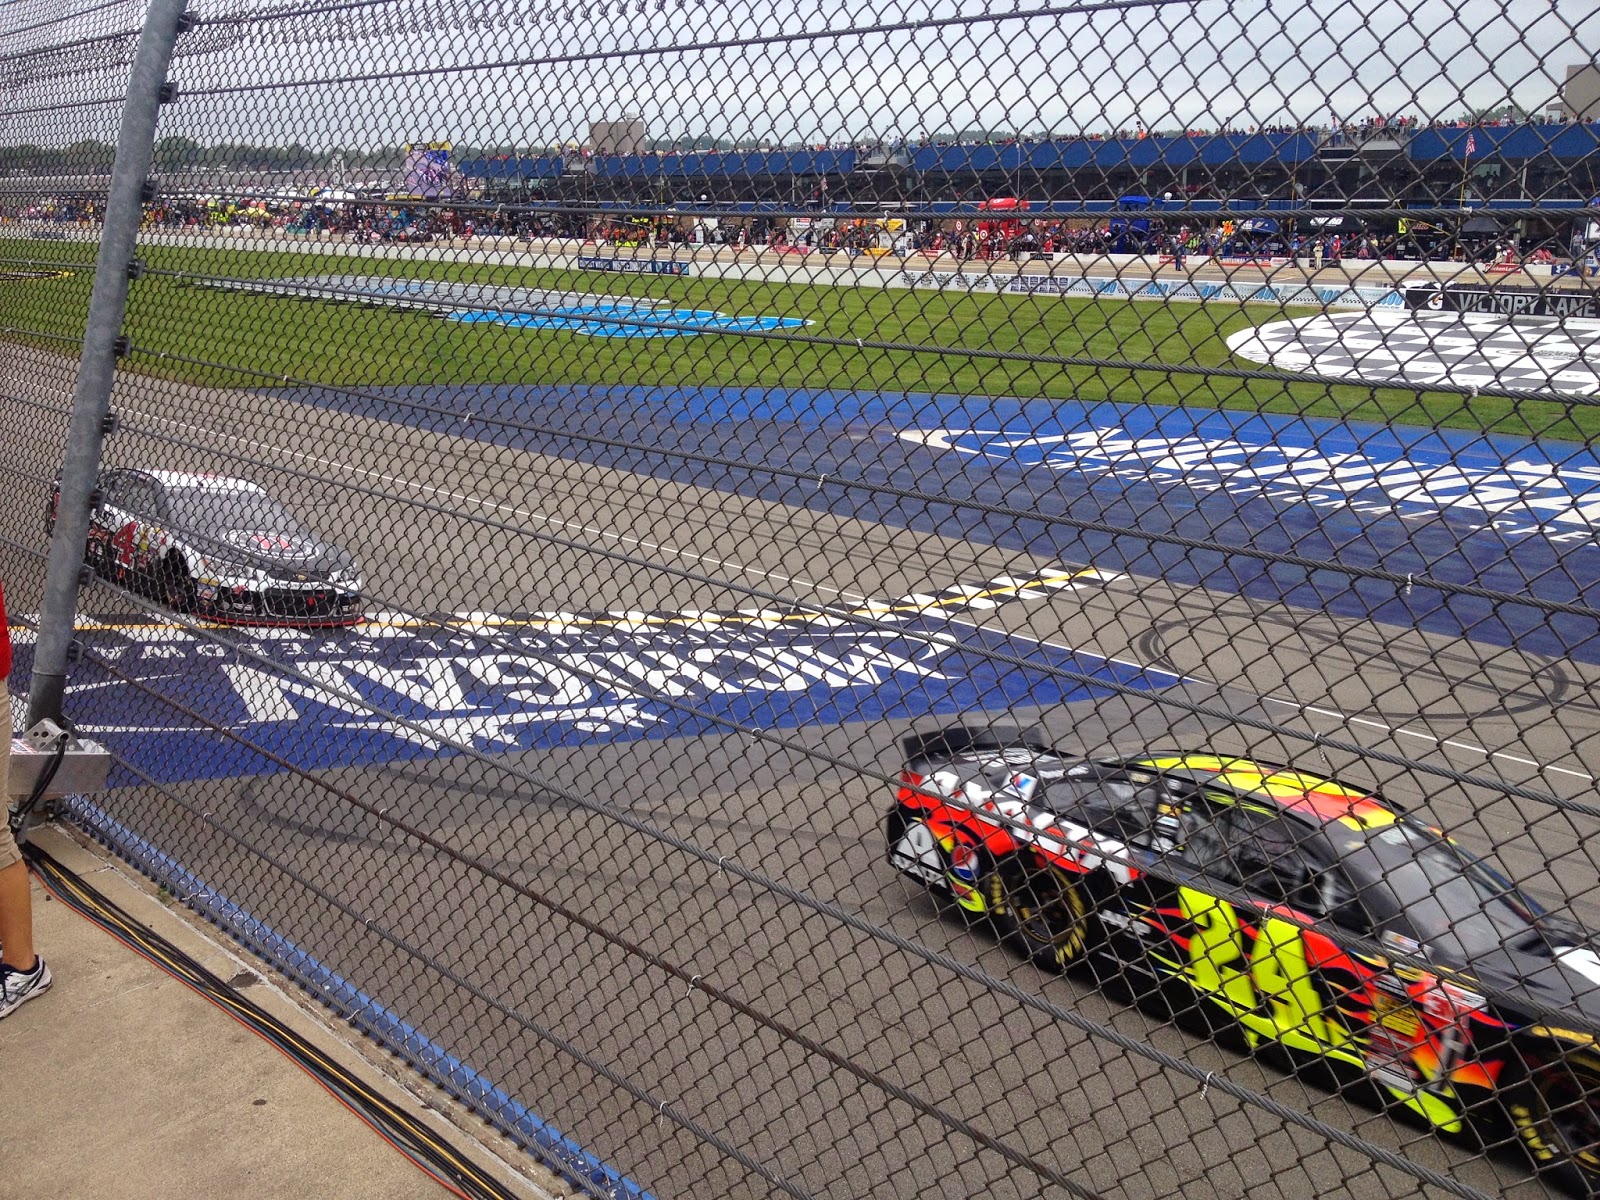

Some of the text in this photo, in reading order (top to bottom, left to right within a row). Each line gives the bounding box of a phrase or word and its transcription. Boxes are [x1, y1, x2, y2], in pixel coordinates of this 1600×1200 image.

[1459, 293, 1598, 318] VICTORY LANE
[985, 427, 1600, 525] MICHIGA
[1022, 459, 1439, 520] INTERNATIONAL
[113, 520, 136, 568] 4
[1469, 520, 1600, 547] SPE
[89, 641, 381, 660] SPEEDWA
[220, 643, 962, 722] MICHIGAN
[1177, 885, 1335, 1048] 24
